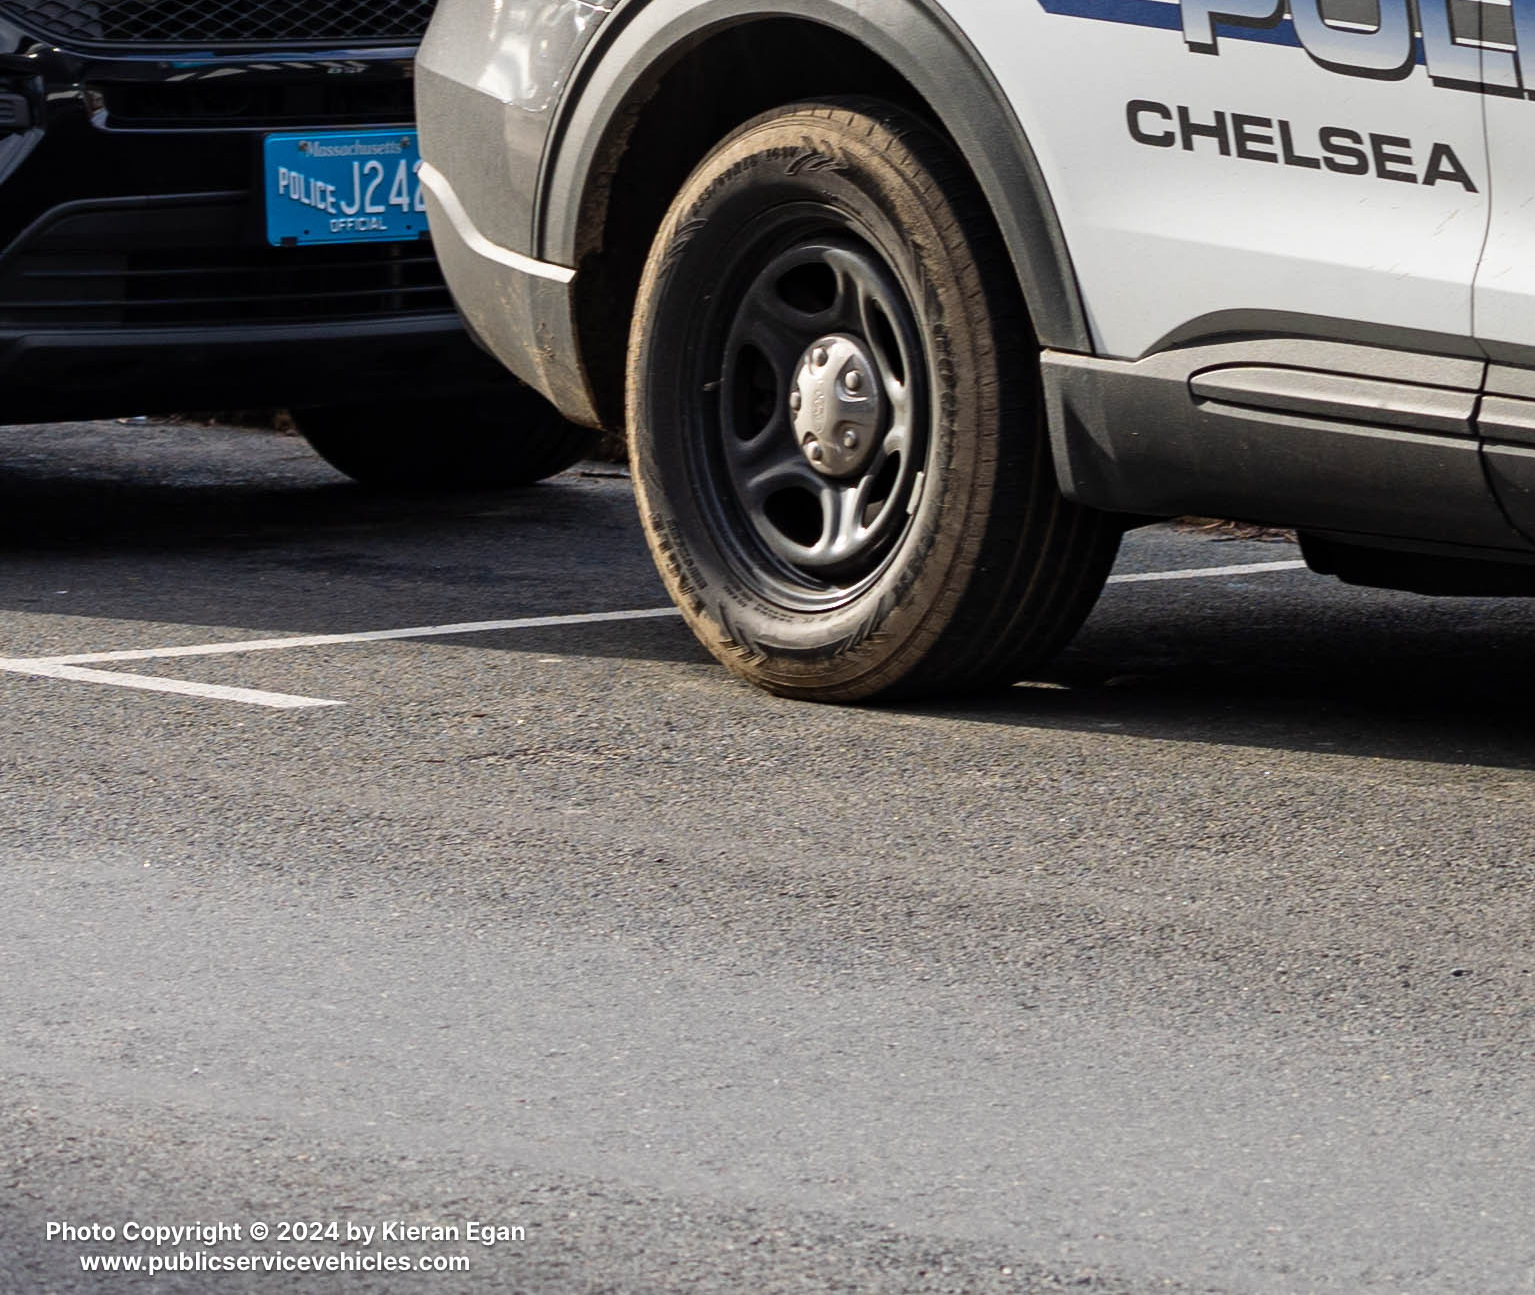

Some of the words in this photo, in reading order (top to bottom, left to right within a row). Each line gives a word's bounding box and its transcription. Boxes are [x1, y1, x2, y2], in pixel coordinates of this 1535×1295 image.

[306, 139, 402, 157] Massachusetts
[1126, 99, 1479, 193] CHELSEA
[278, 166, 337, 205] POLICE
[330, 217, 388, 233] OFFICIAL
